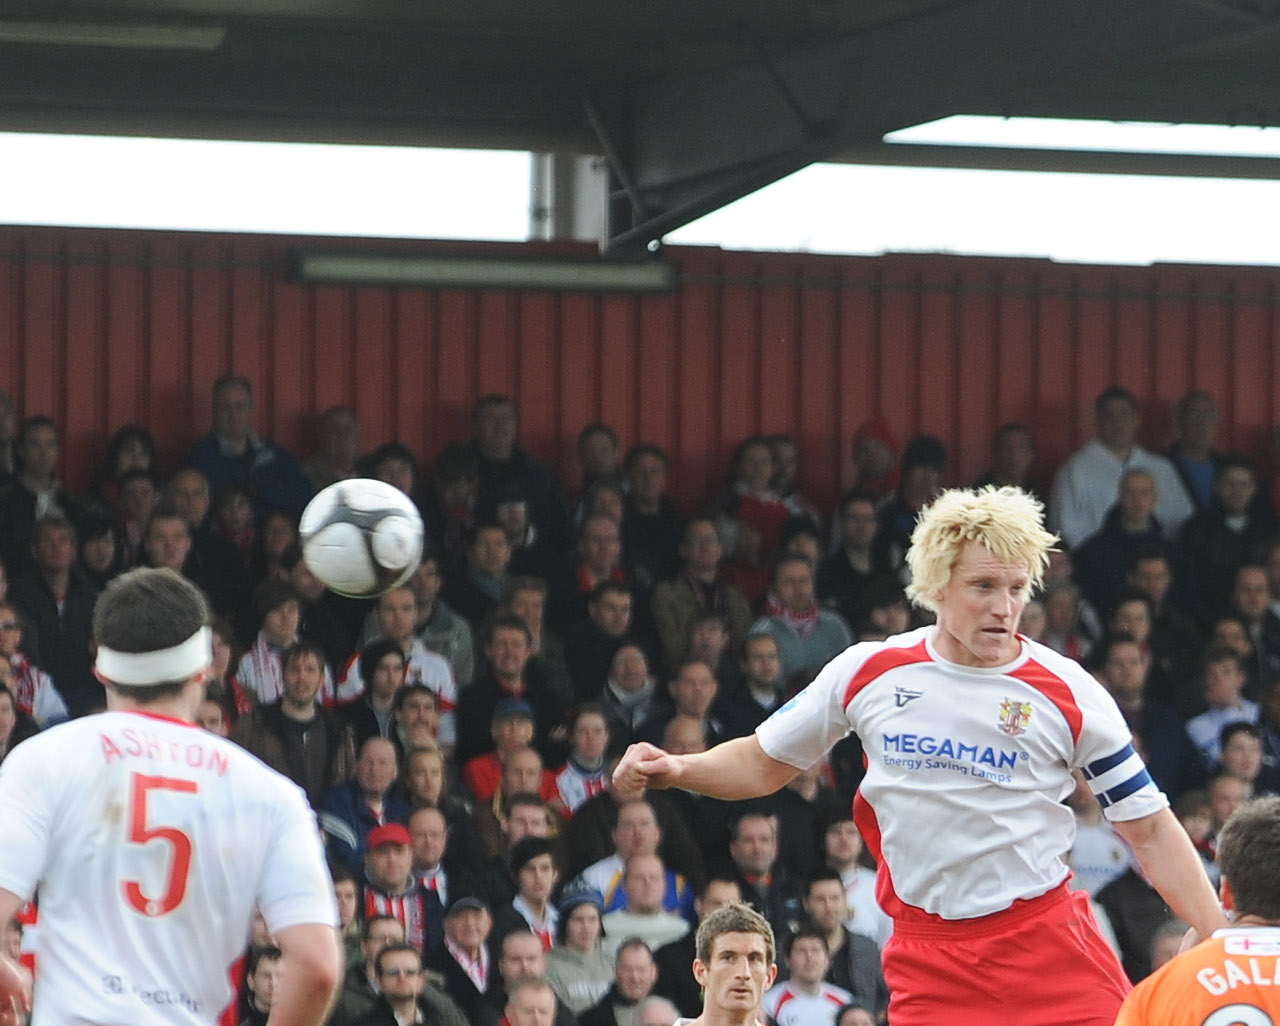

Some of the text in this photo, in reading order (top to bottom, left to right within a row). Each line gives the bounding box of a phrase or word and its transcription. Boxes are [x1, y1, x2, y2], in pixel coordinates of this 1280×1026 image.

[100, 728, 229, 778] ASHTON
[884, 755, 1012, 783] Energy Saving Lamps
[121, 770, 198, 917] 5
